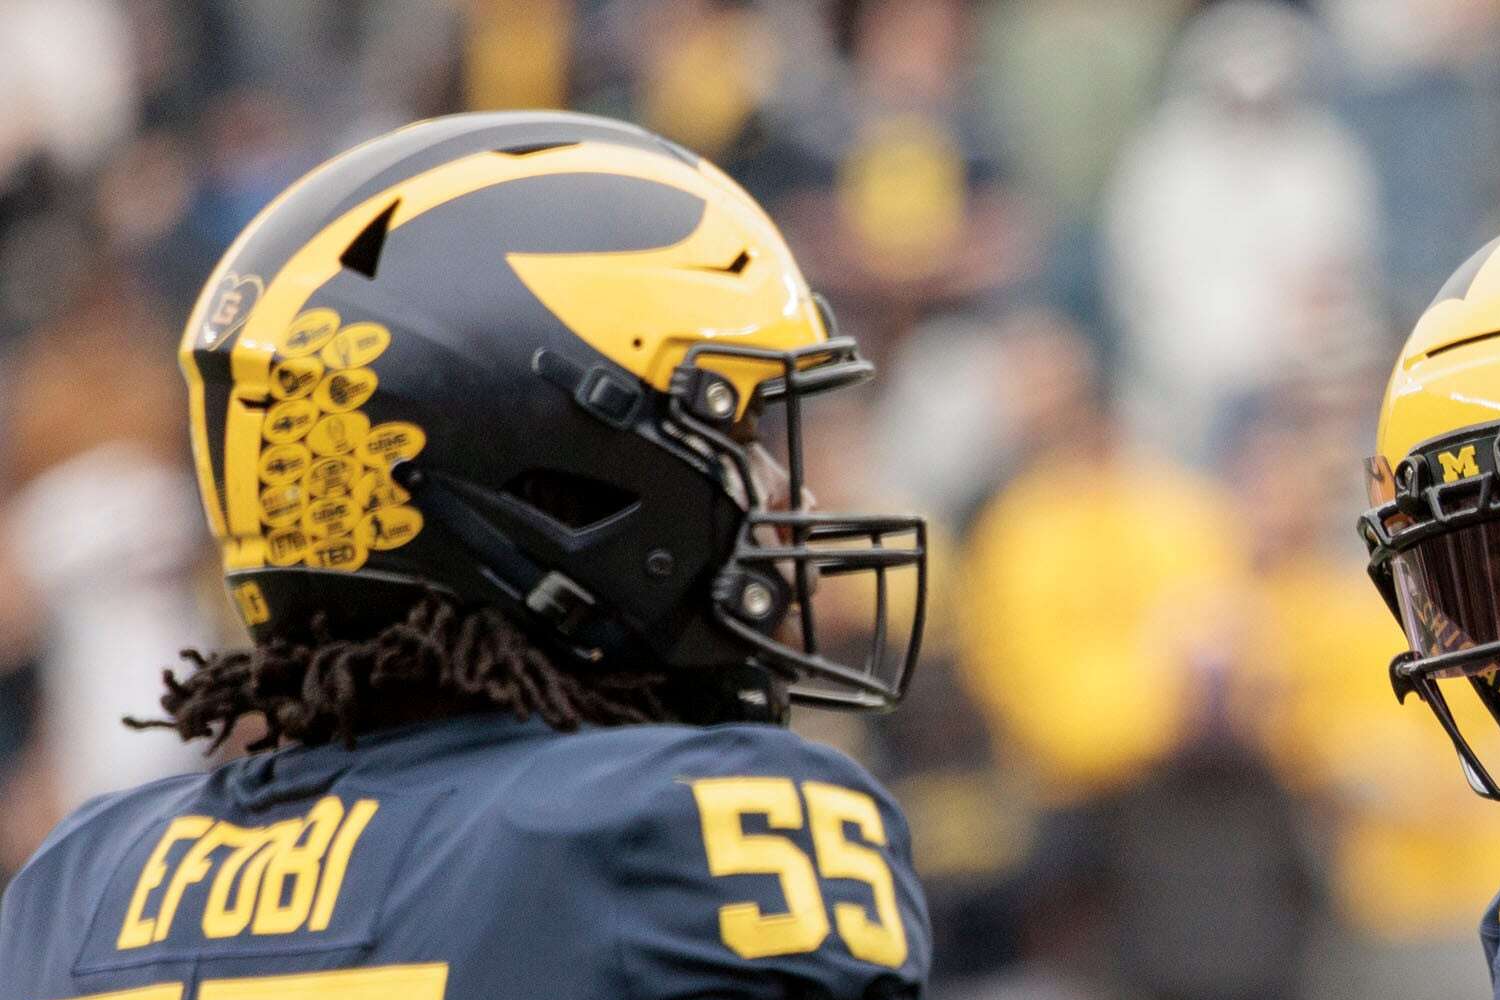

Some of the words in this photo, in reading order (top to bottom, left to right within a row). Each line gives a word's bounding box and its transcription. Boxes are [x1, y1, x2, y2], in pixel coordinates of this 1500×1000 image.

[1438, 444, 1480, 482] M
[116, 795, 380, 951] EFOBI
[690, 776, 909, 970] 55
